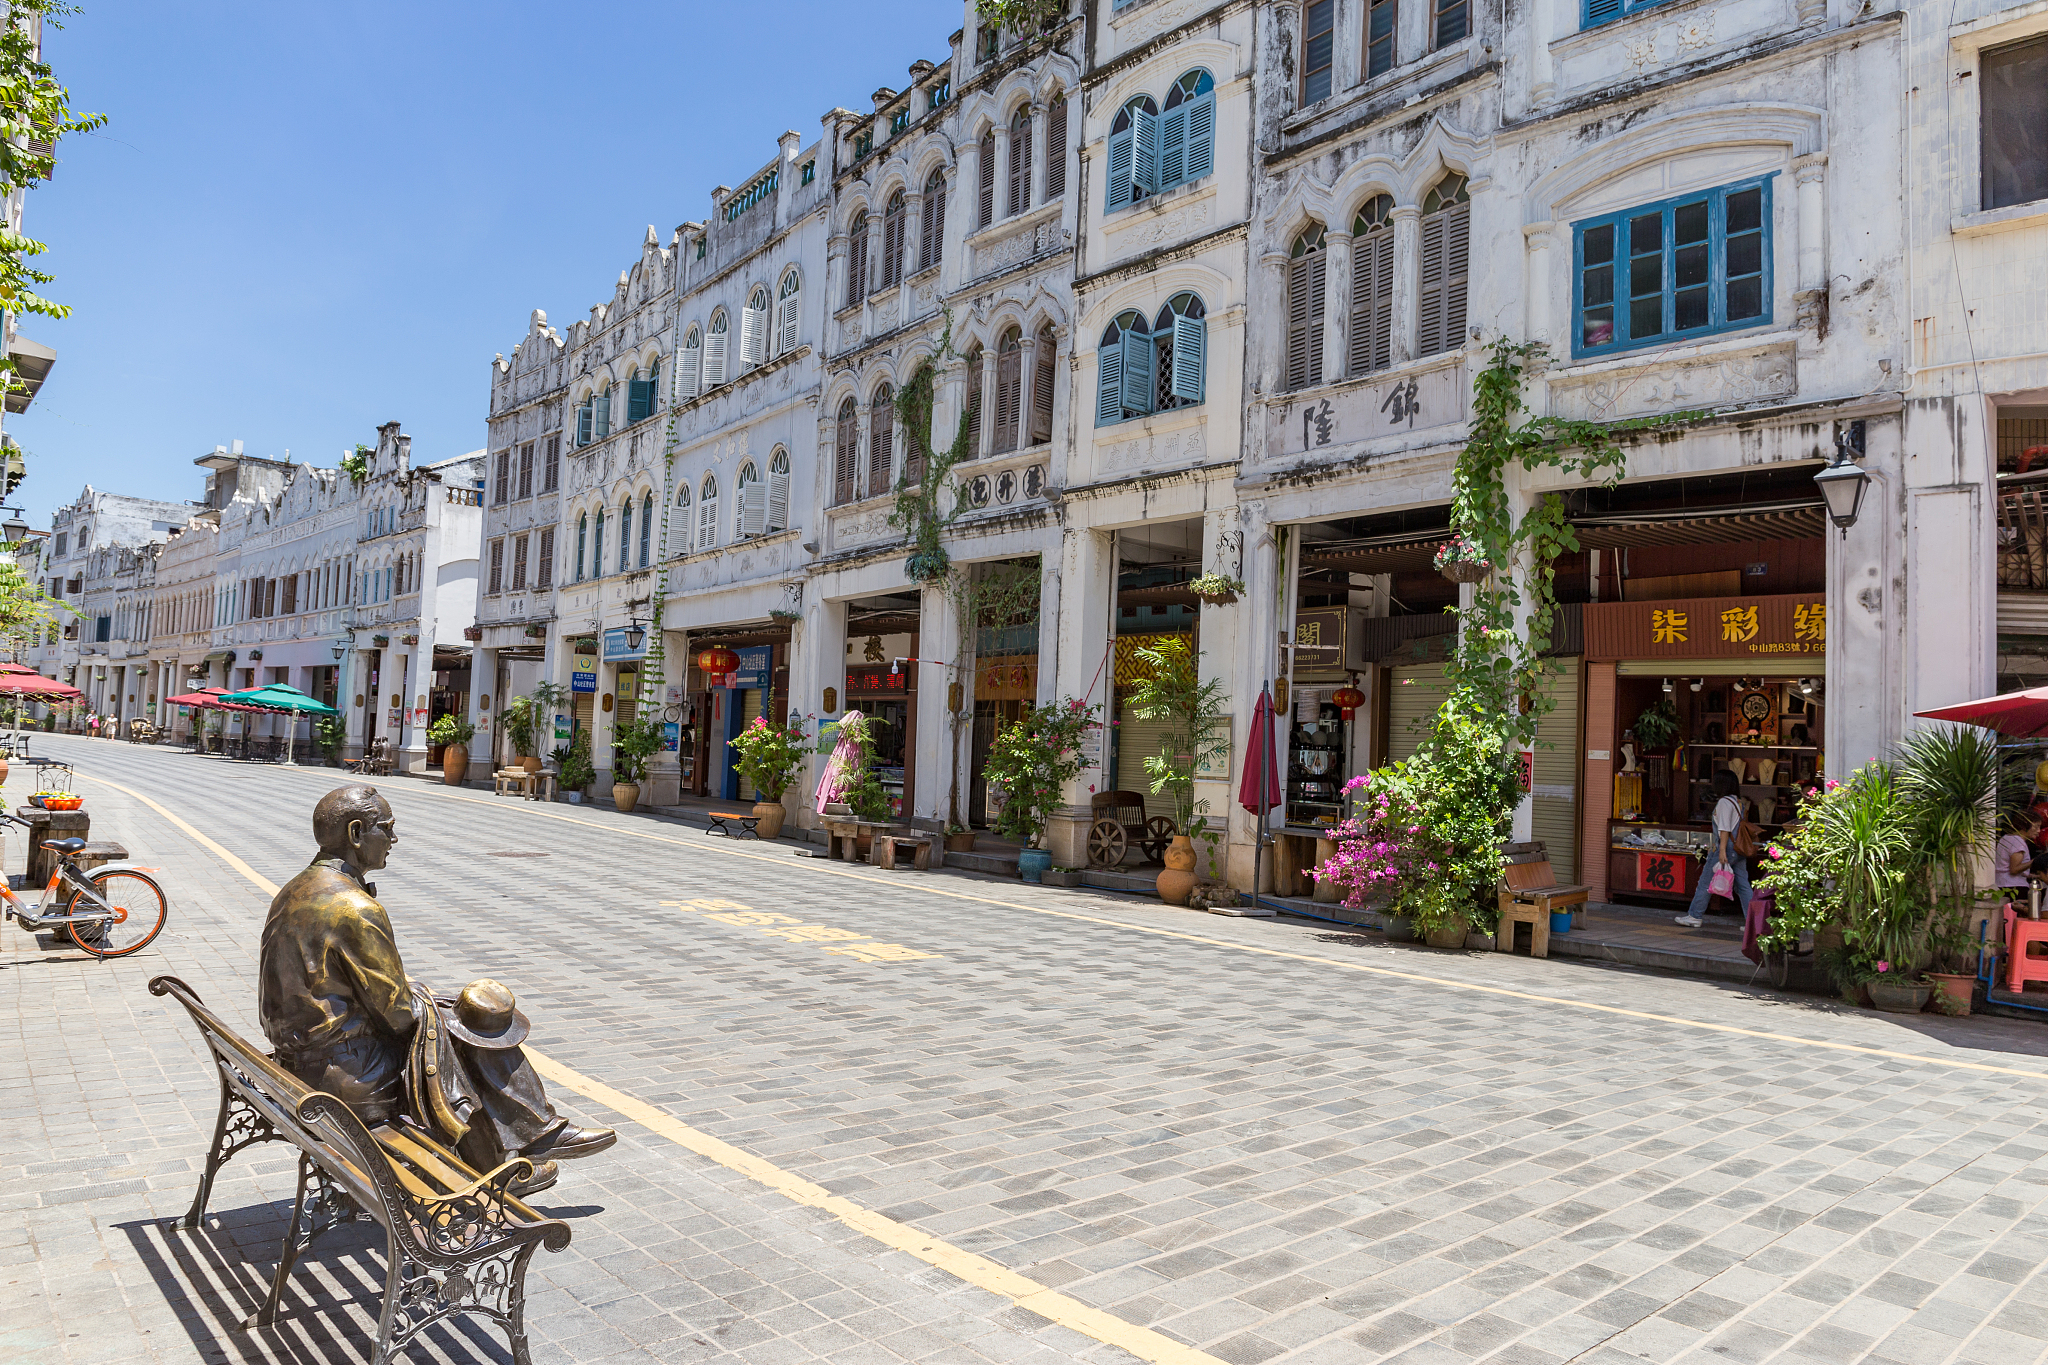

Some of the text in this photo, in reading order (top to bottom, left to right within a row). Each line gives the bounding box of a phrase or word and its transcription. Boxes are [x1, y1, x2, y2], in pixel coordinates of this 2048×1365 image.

[1645, 856, 1675, 890] 福
[658, 898, 945, 963] 消防通道
